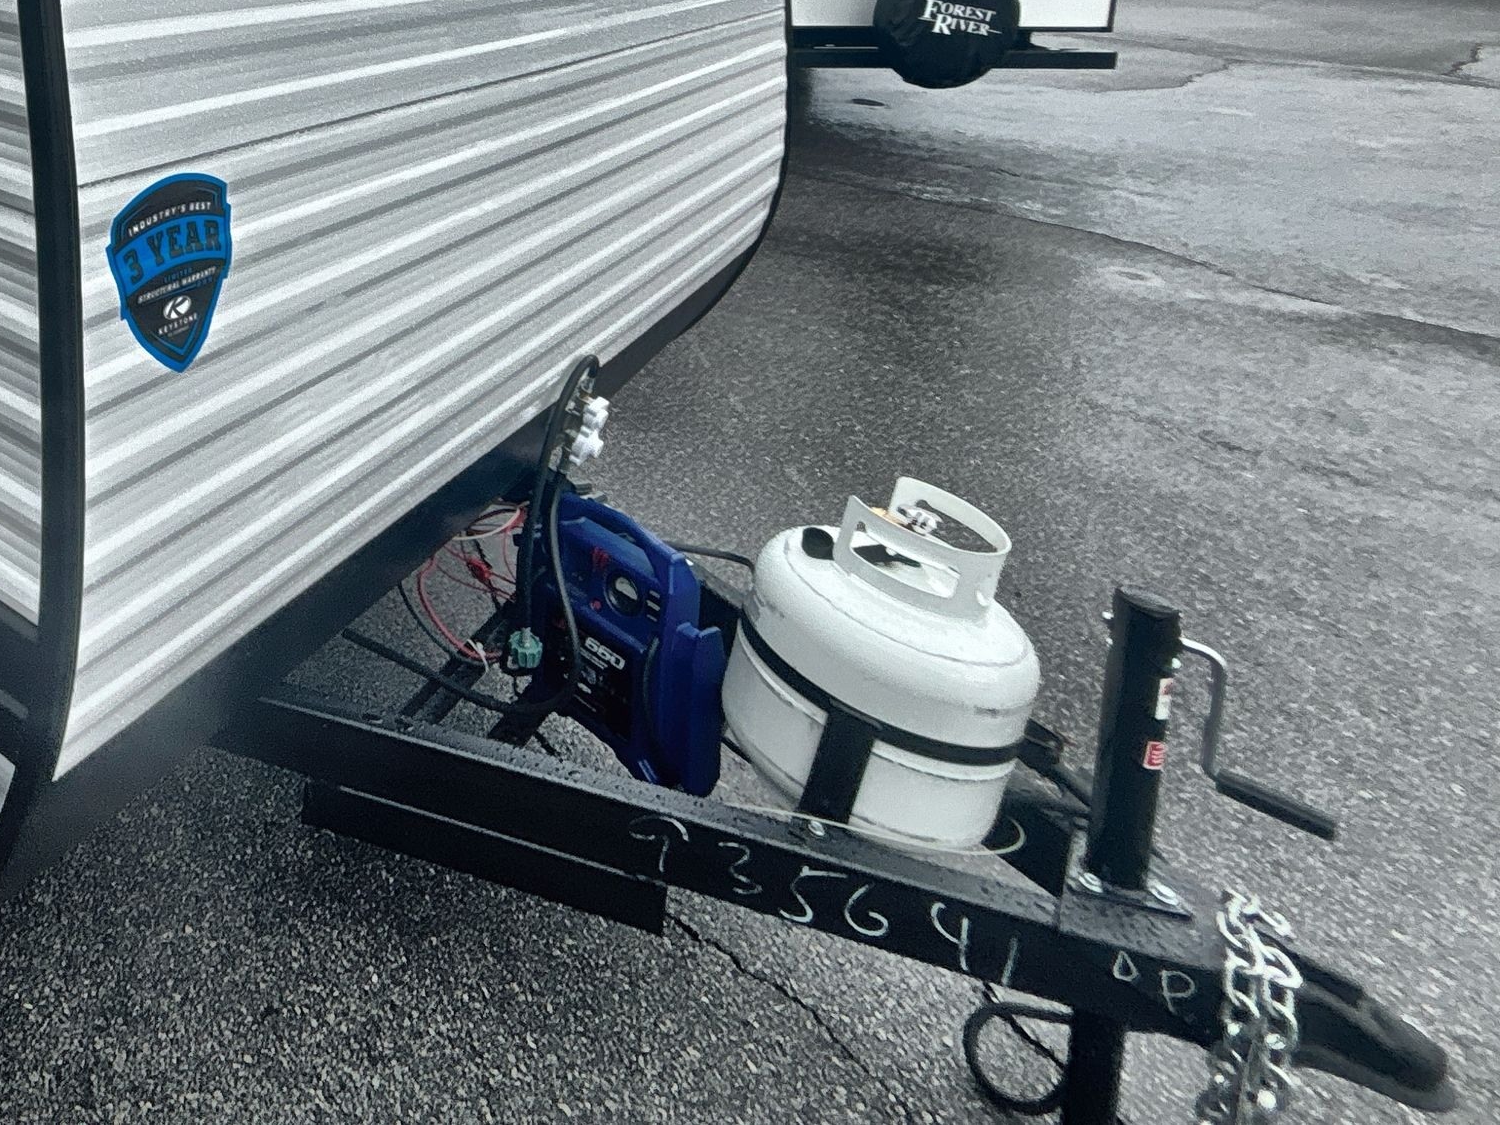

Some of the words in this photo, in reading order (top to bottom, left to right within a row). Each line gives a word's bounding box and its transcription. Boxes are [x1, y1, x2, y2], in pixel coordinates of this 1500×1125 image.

[922, 0, 997, 22] FOREST
[932, 13, 990, 36] RIVER
[128, 204, 186, 237] INDUSTRY'S
[189, 201, 211, 211] BEST
[123, 249, 144, 285] 3
[146, 220, 221, 266] YEAR
[182, 266, 216, 286] WARRANTY
[159, 312, 197, 334] KEYSTONE
